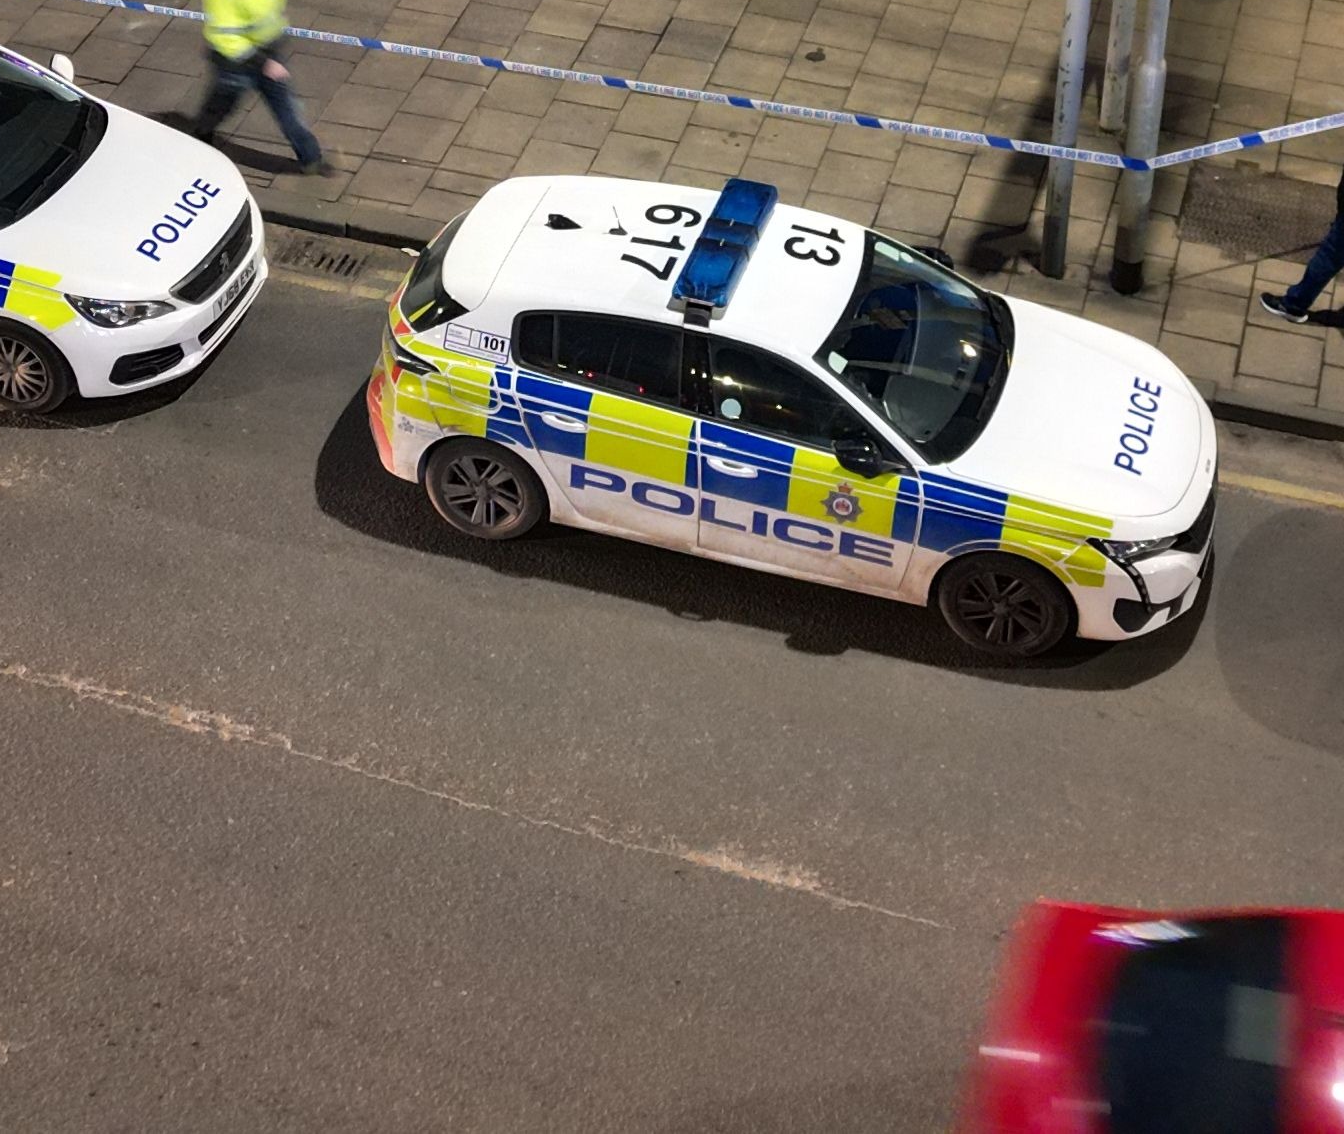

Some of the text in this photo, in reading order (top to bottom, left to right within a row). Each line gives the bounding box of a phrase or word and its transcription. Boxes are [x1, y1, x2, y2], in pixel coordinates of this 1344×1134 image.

[888, 122, 984, 143] POLICE LINE DO NOT CROSS
[136, 178, 220, 262] POLICE
[620, 204, 702, 281] 617
[784, 224, 846, 266] 13
[483, 336, 506, 353] 101
[1113, 377, 1162, 476] POLICE
[570, 463, 894, 567] POLICE
